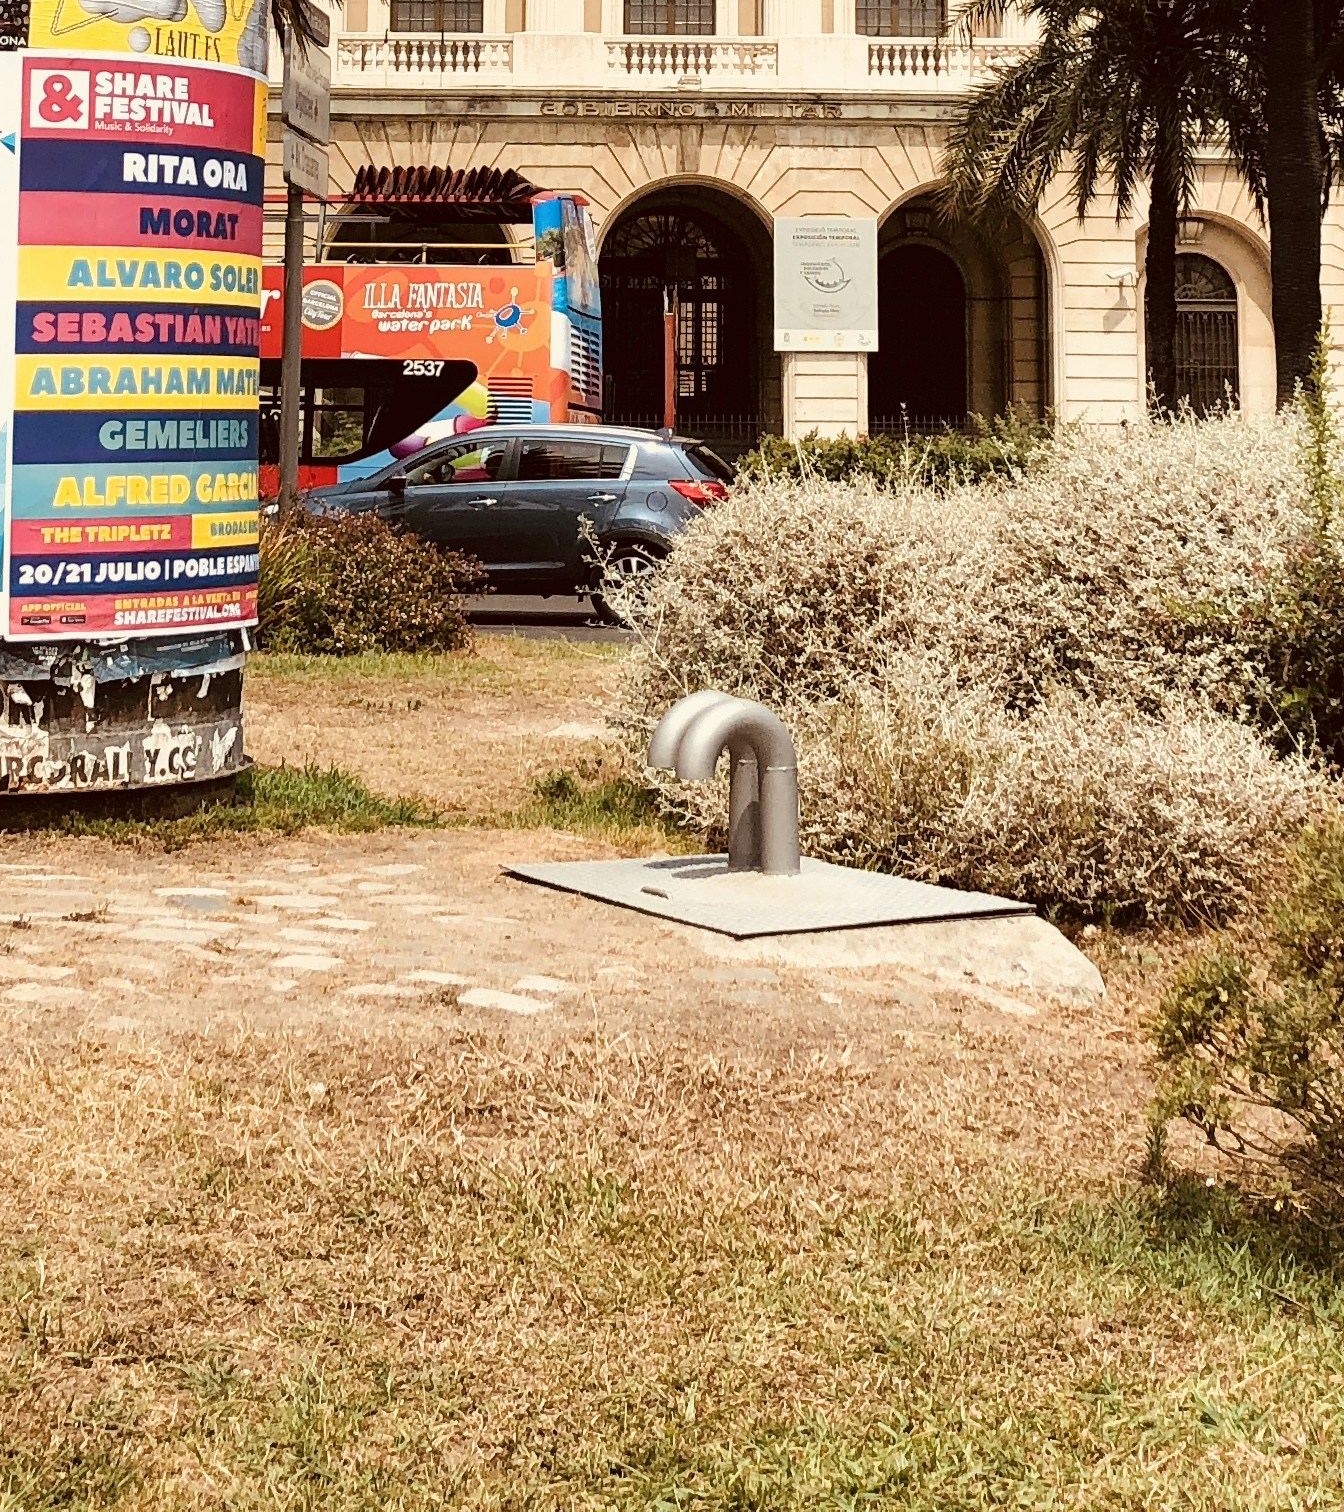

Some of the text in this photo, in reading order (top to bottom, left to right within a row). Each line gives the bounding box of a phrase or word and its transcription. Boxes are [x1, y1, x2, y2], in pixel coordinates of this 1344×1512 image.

[94, 71, 189, 101] SHARE
[94, 96, 214, 128] FESTIVAL
[540, 100, 844, 119] GOBIERNO MILITAR
[94, 120, 174, 136] Music & Solidarity
[122, 152, 248, 192] RITA ORA
[139, 207, 240, 240] MORAT
[67, 259, 204, 290] ALVARO
[302, 297, 338, 311] BARCELONA
[362, 282, 484, 309] ILLA FANTASIA
[31, 307, 221, 344] SEBASTIÁN
[372, 309, 432, 319] Barcelona's
[378, 315, 473, 334] water park
[29, 367, 211, 395] ABRAHAM
[403, 360, 445, 377] 2537
[99, 420, 249, 450] GEMELIERS
[52, 474, 191, 506] ALFRED
[40, 527, 82, 544] THE
[85, 524, 172, 543] TRIPLETZ
[18, 561, 92, 586] 20/21
[94, 560, 161, 584] JULIO
[173, 555, 225, 579] POBLE
[21, 603, 41, 612] APP
[114, 597, 179, 610] ENTRADAS
[183, 595, 190, 607] A
[192, 594, 205, 606] LA
[114, 603, 241, 626] SHAREFESTIVAL.ORG
